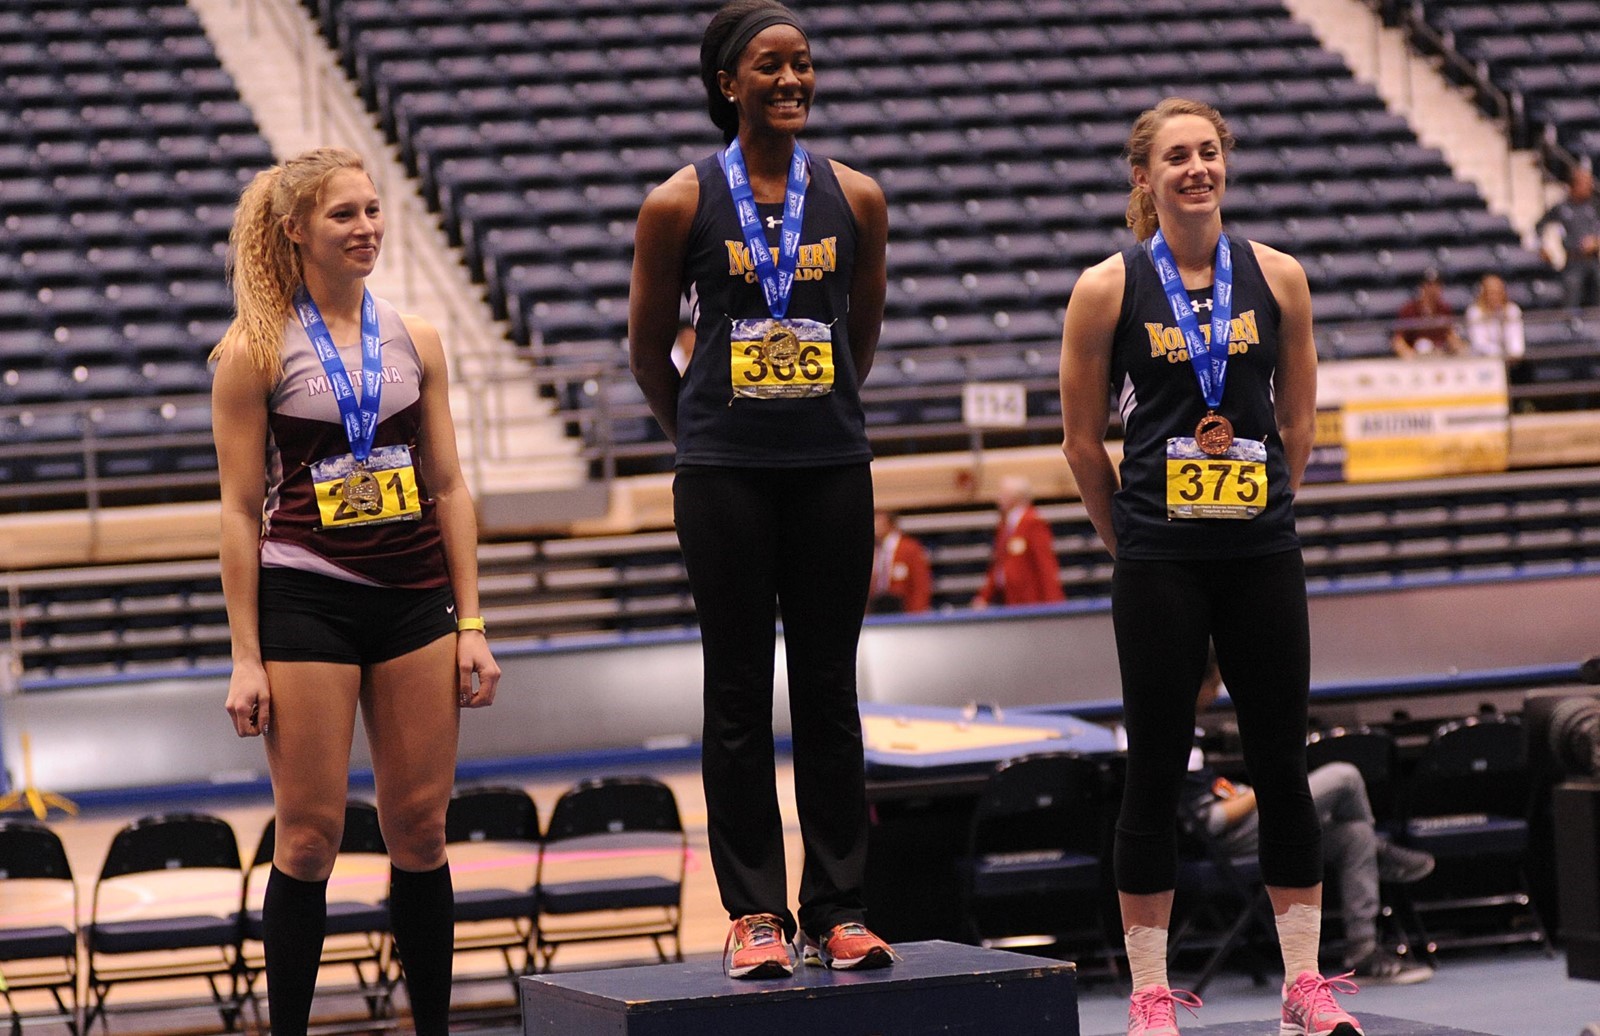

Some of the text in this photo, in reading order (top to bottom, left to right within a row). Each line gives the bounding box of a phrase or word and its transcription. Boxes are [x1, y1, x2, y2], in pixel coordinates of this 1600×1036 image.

[725, 236, 837, 276] NOTERN
[745, 268, 824, 284] CADO
[1144, 309, 1260, 358] NOTRN
[1167, 341, 1249, 364] CODO
[305, 366, 404, 397] MTNA
[1179, 463, 1260, 502] 375
